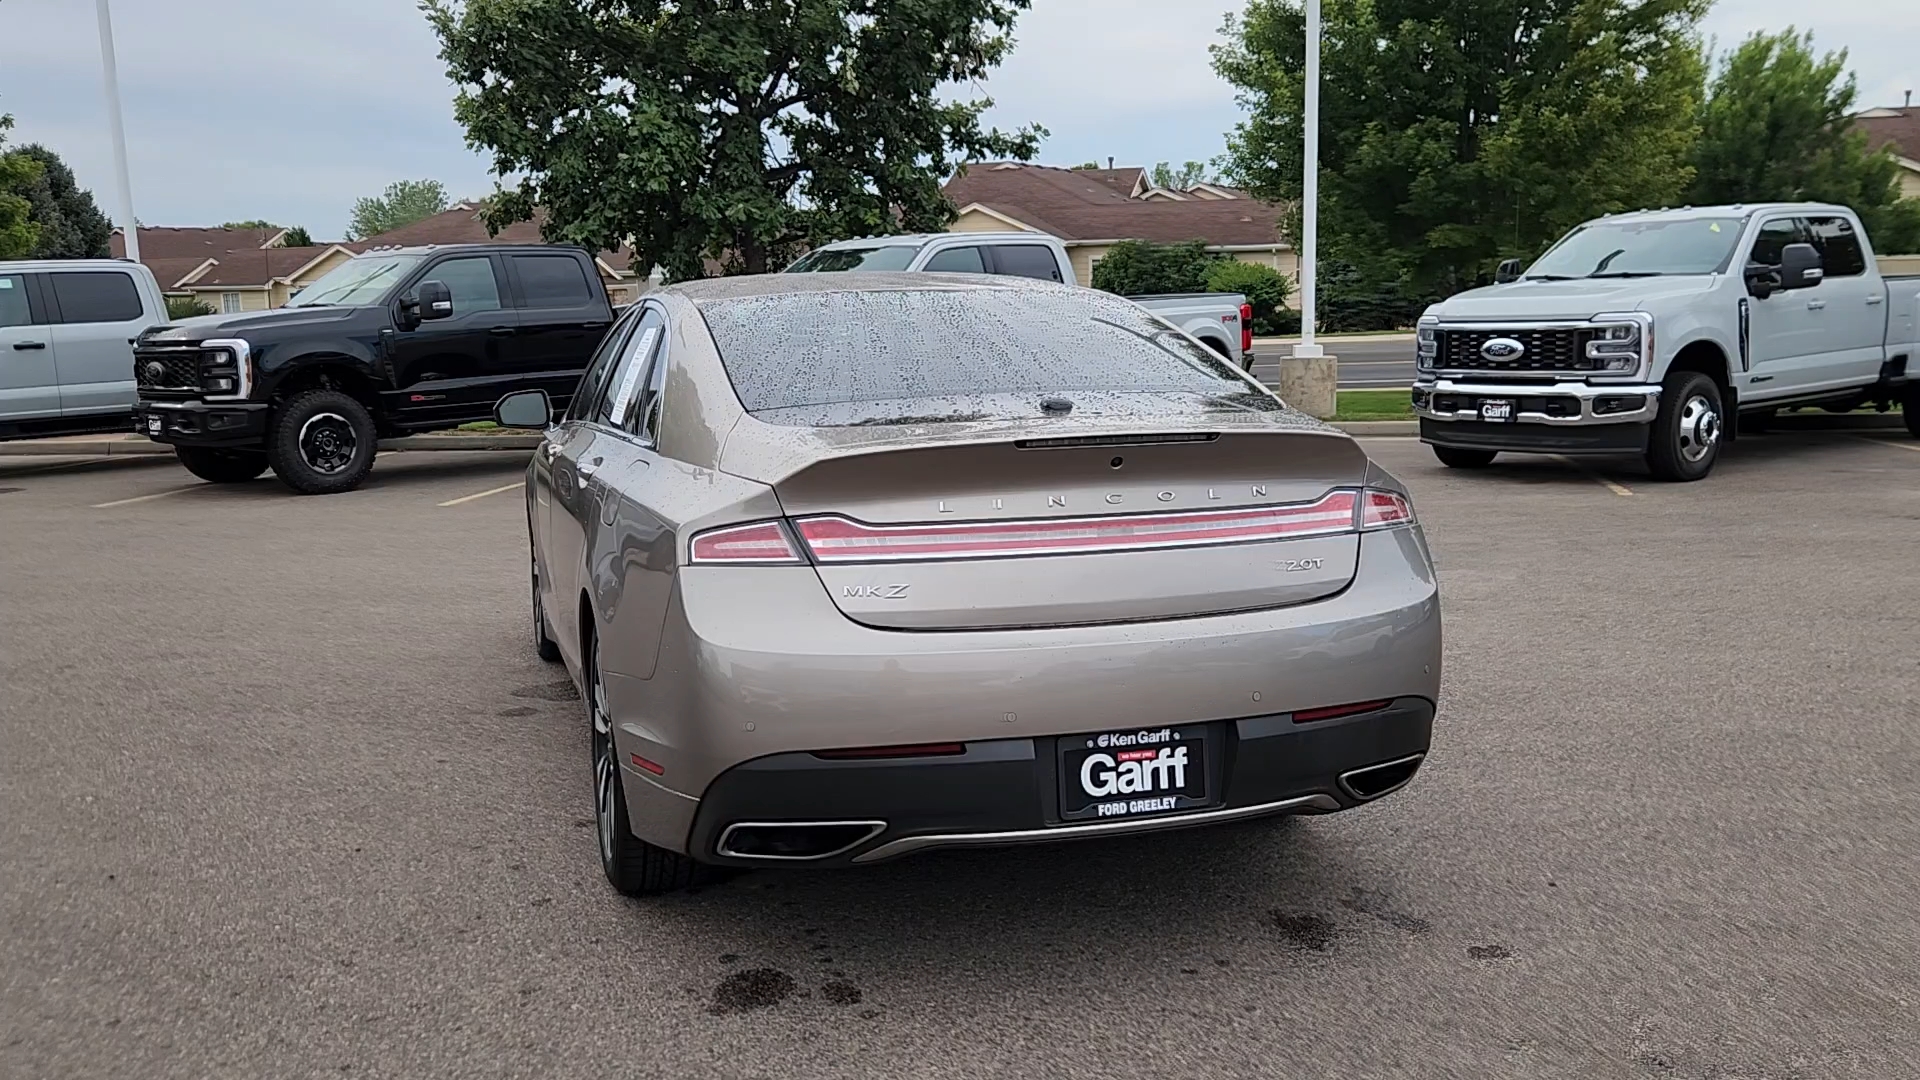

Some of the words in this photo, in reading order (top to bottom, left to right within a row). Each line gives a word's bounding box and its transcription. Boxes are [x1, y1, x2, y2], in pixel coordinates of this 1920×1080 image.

[1489, 344, 1511, 355] Ford
[1482, 404, 1511, 417] Garff
[939, 484, 1268, 513] LINCOLN
[843, 583, 911, 600] MKZ
[1110, 732, 1136, 746] Ken
[1137, 728, 1171, 744] Garff
[1080, 746, 1188, 797] Garff
[1097, 801, 1128, 817] FORD
[1129, 796, 1177, 813] GREELEY
